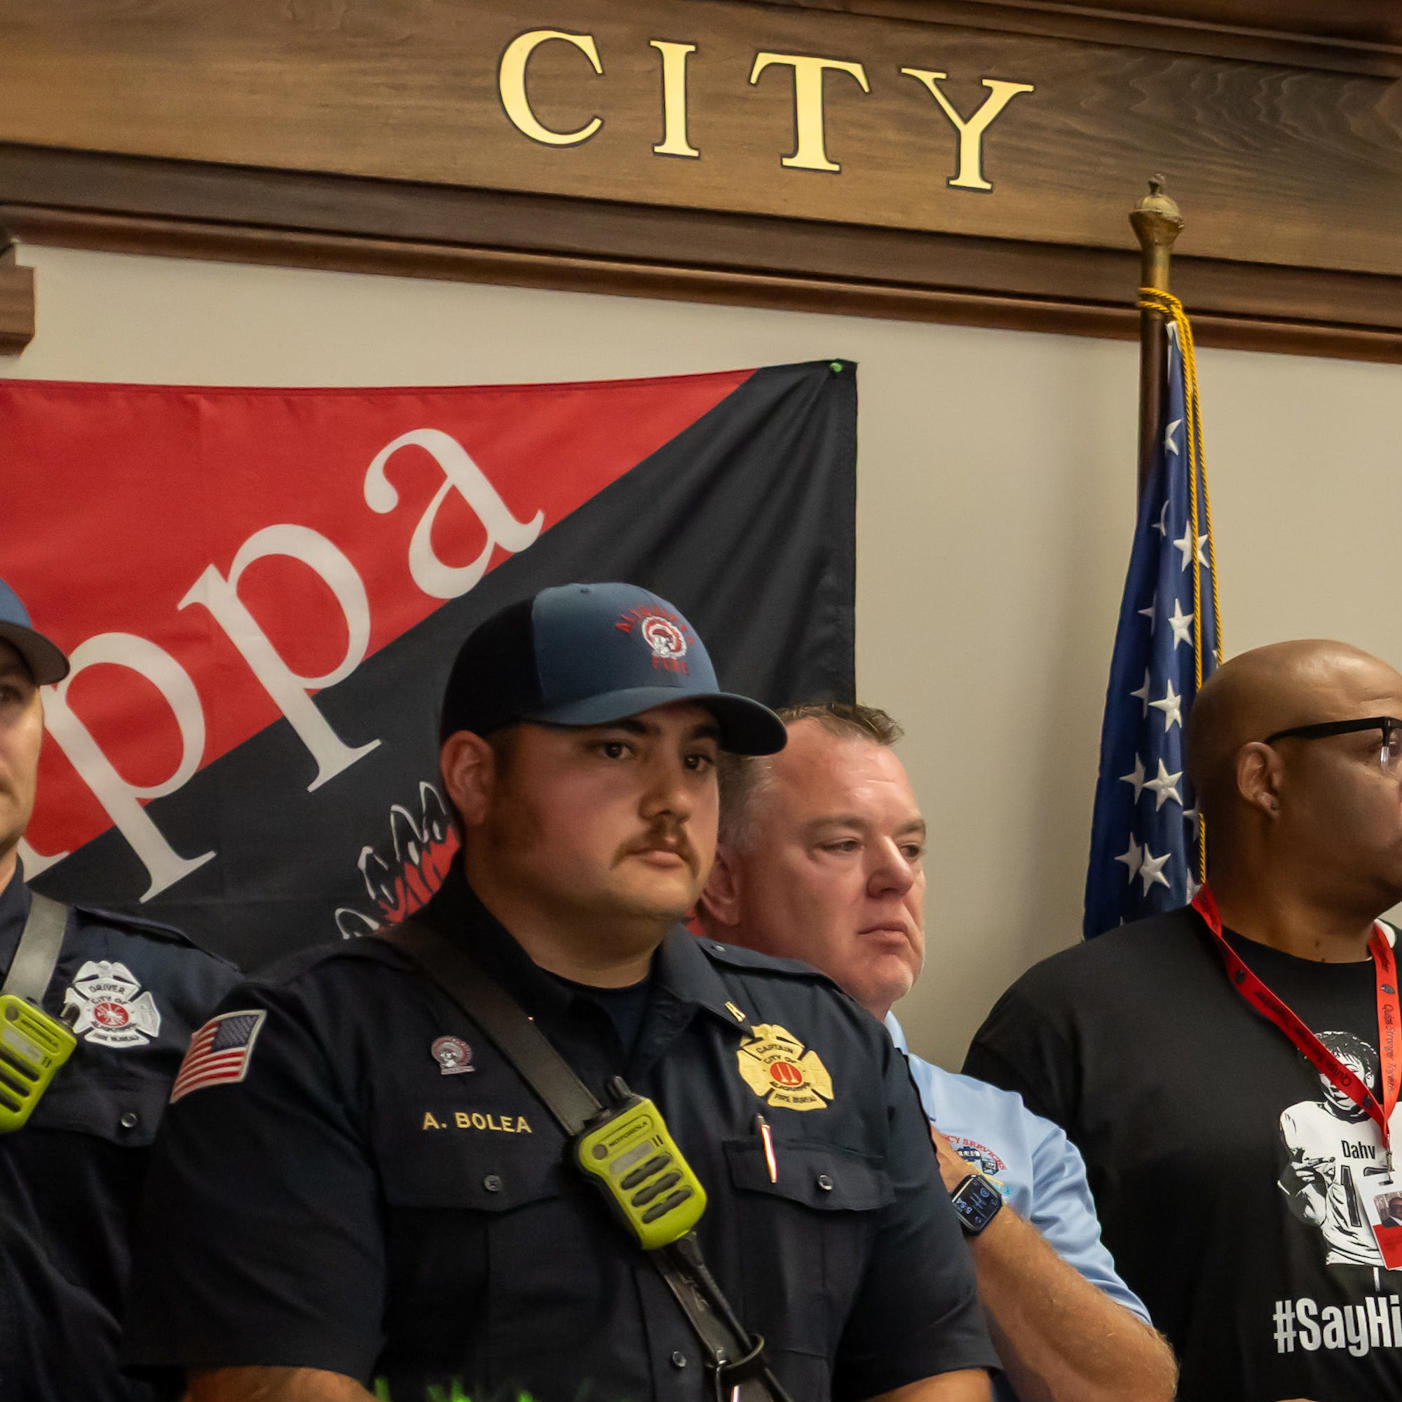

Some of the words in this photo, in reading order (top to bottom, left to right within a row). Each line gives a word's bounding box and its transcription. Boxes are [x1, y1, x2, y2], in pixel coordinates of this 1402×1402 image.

[498, 30, 1034, 191] CITY
[18, 427, 545, 903] ppa
[89, 983, 126, 994] DRIVER
[756, 1044, 794, 1054] CAPTAIN
[423, 1112, 448, 1130] A.
[455, 1112, 532, 1134] BOLEA
